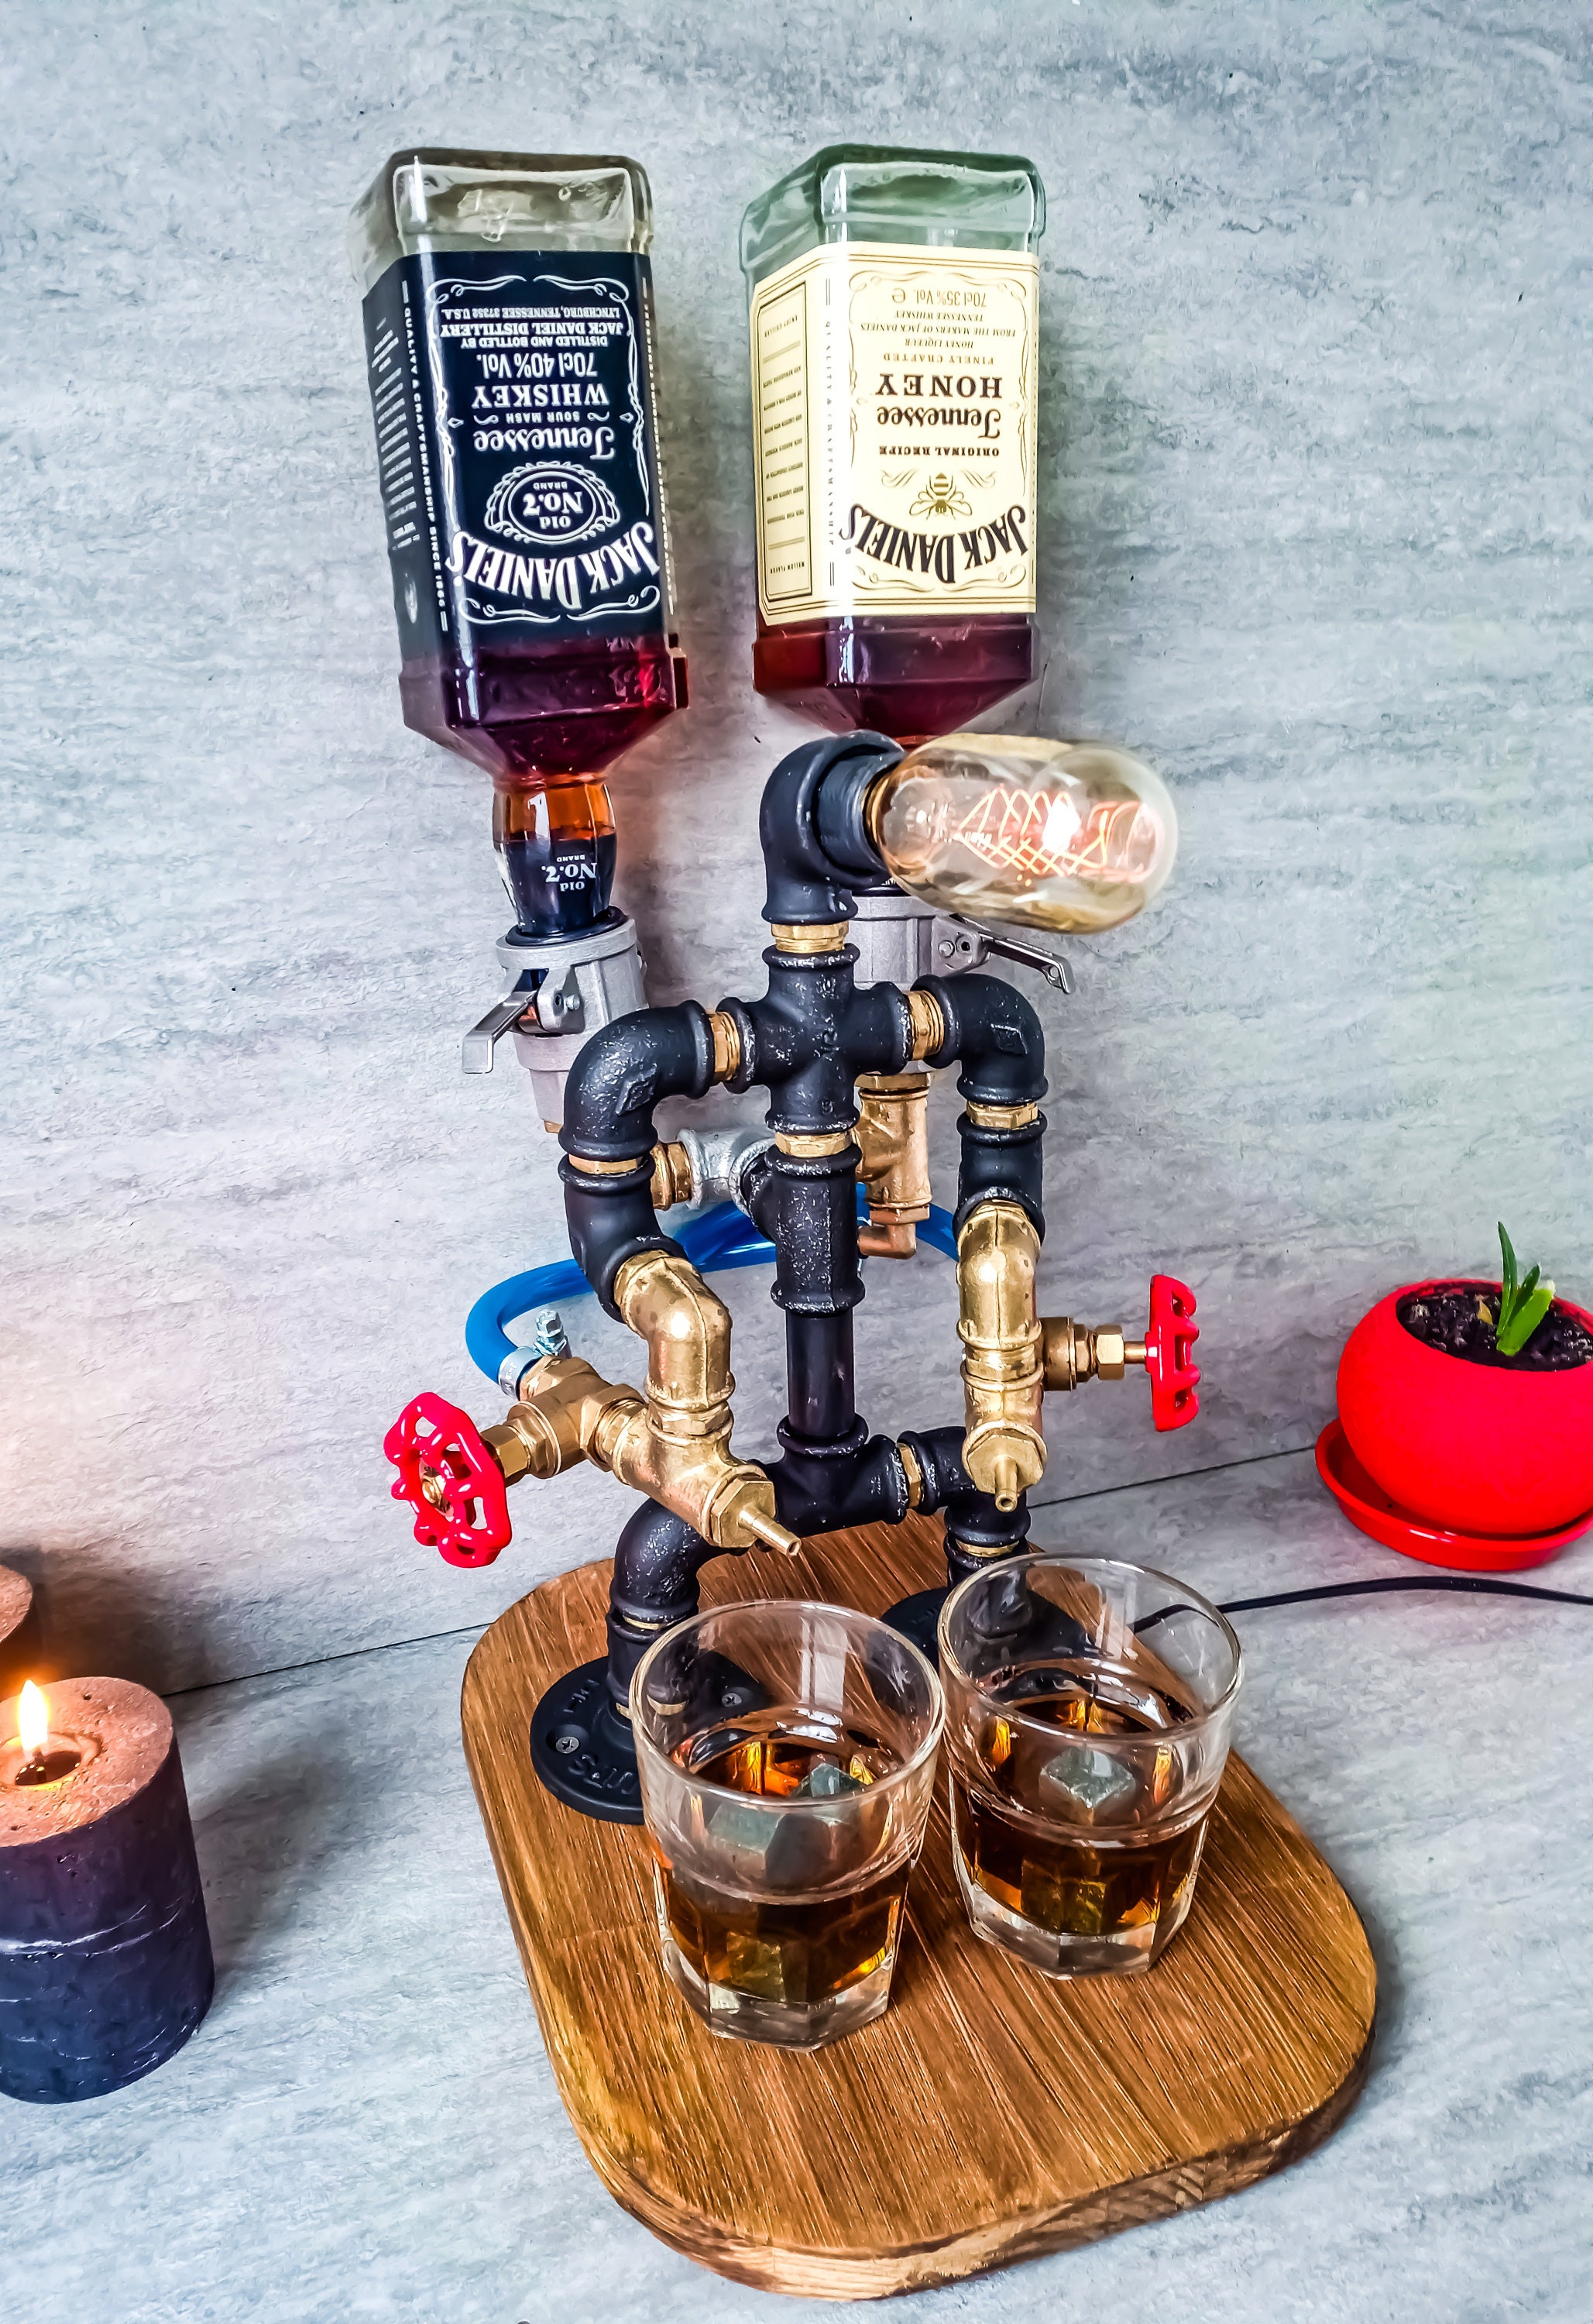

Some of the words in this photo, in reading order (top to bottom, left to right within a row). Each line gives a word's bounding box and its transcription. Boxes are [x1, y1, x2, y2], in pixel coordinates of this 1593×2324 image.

[964, 292, 987, 308] 70cl
[441, 308, 470, 319] U.S.A.
[503, 307, 561, 319] TENNESSEE
[561, 305, 620, 319] LYNCHBURG,
[440, 323, 530, 338] DISTILLERY
[531, 322, 586, 336] DANIEL
[588, 322, 623, 335] JACK
[460, 338, 477, 349] BY
[479, 337, 528, 348] BOTTLED
[531, 336, 553, 348] AND
[556, 335, 609, 348] DISTILLED
[475, 354, 512, 380] Vol.
[513, 352, 555, 379] 40%
[558, 352, 599, 378] 70cl
[949, 356, 994, 365] FINELY
[875, 373, 1003, 399] HONEY
[471, 383, 610, 409] WHISKEY
[505, 412, 541, 424] MASH
[546, 411, 580, 424] SOUR
[877, 407, 1001, 439] Tennessee
[404, 308, 418, 374] QUALITY
[414, 393, 435, 522] CRAFTSMANSHIP
[429, 527, 441, 571] SINCE
[472, 427, 616, 460] Tennessee
[878, 445, 930, 456] RECIPE
[935, 446, 1000, 457] ORIGINAL
[533, 482, 568, 490] BRAND
[540, 516, 571, 529] Old
[957, 505, 1028, 571] JACK
[578, 521, 661, 593] JACK
[445, 531, 582, 610] DANIEL'S
[560, 882, 585, 892] Old
